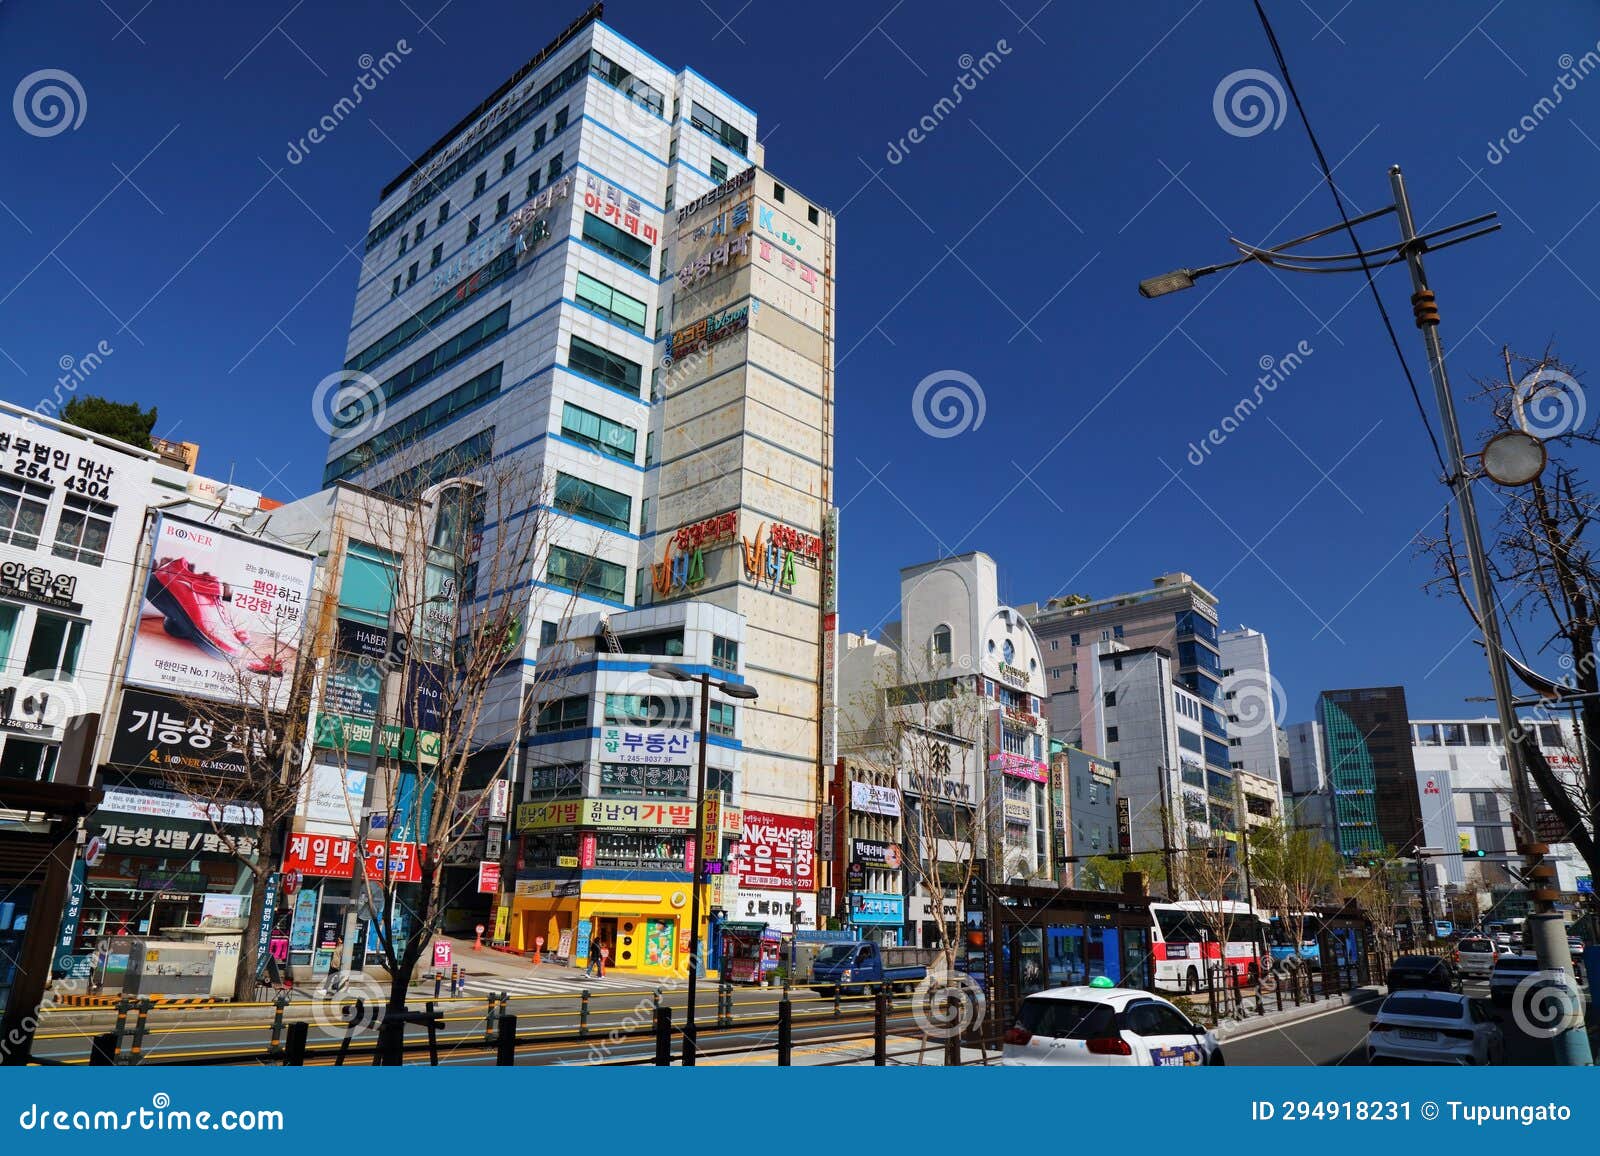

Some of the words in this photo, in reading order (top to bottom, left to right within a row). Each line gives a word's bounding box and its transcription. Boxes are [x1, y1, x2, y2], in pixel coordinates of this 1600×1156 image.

[585, 192, 658, 247] 아카데미
[78, 457, 114, 484] 대산
[64, 476, 109, 500] 4304
[235, 594, 272, 615] 건강한
[276, 604, 300, 621] 신발
[357, 631, 388, 646] HABER
[155, 659, 188, 674] 대한민국
[190, 667, 209, 677] No.1
[128, 710, 213, 748] 기능성
[623, 732, 690, 754] 부동산
[614, 766, 690, 785] 공인중개사
[548, 802, 580, 824] 가발
[642, 804, 694, 826] 가발
[707, 800, 718, 825] 가발
[100, 825, 152, 848] 기능성
[155, 830, 190, 850] 신발
[706, 832, 716, 857] 가발
[704, 861, 722, 874] 가발
[287, 874, 297, 892] 약
[69, 883, 83, 917] 기능성
[60, 924, 76, 946] 신발
[437, 945, 449, 963] 약
